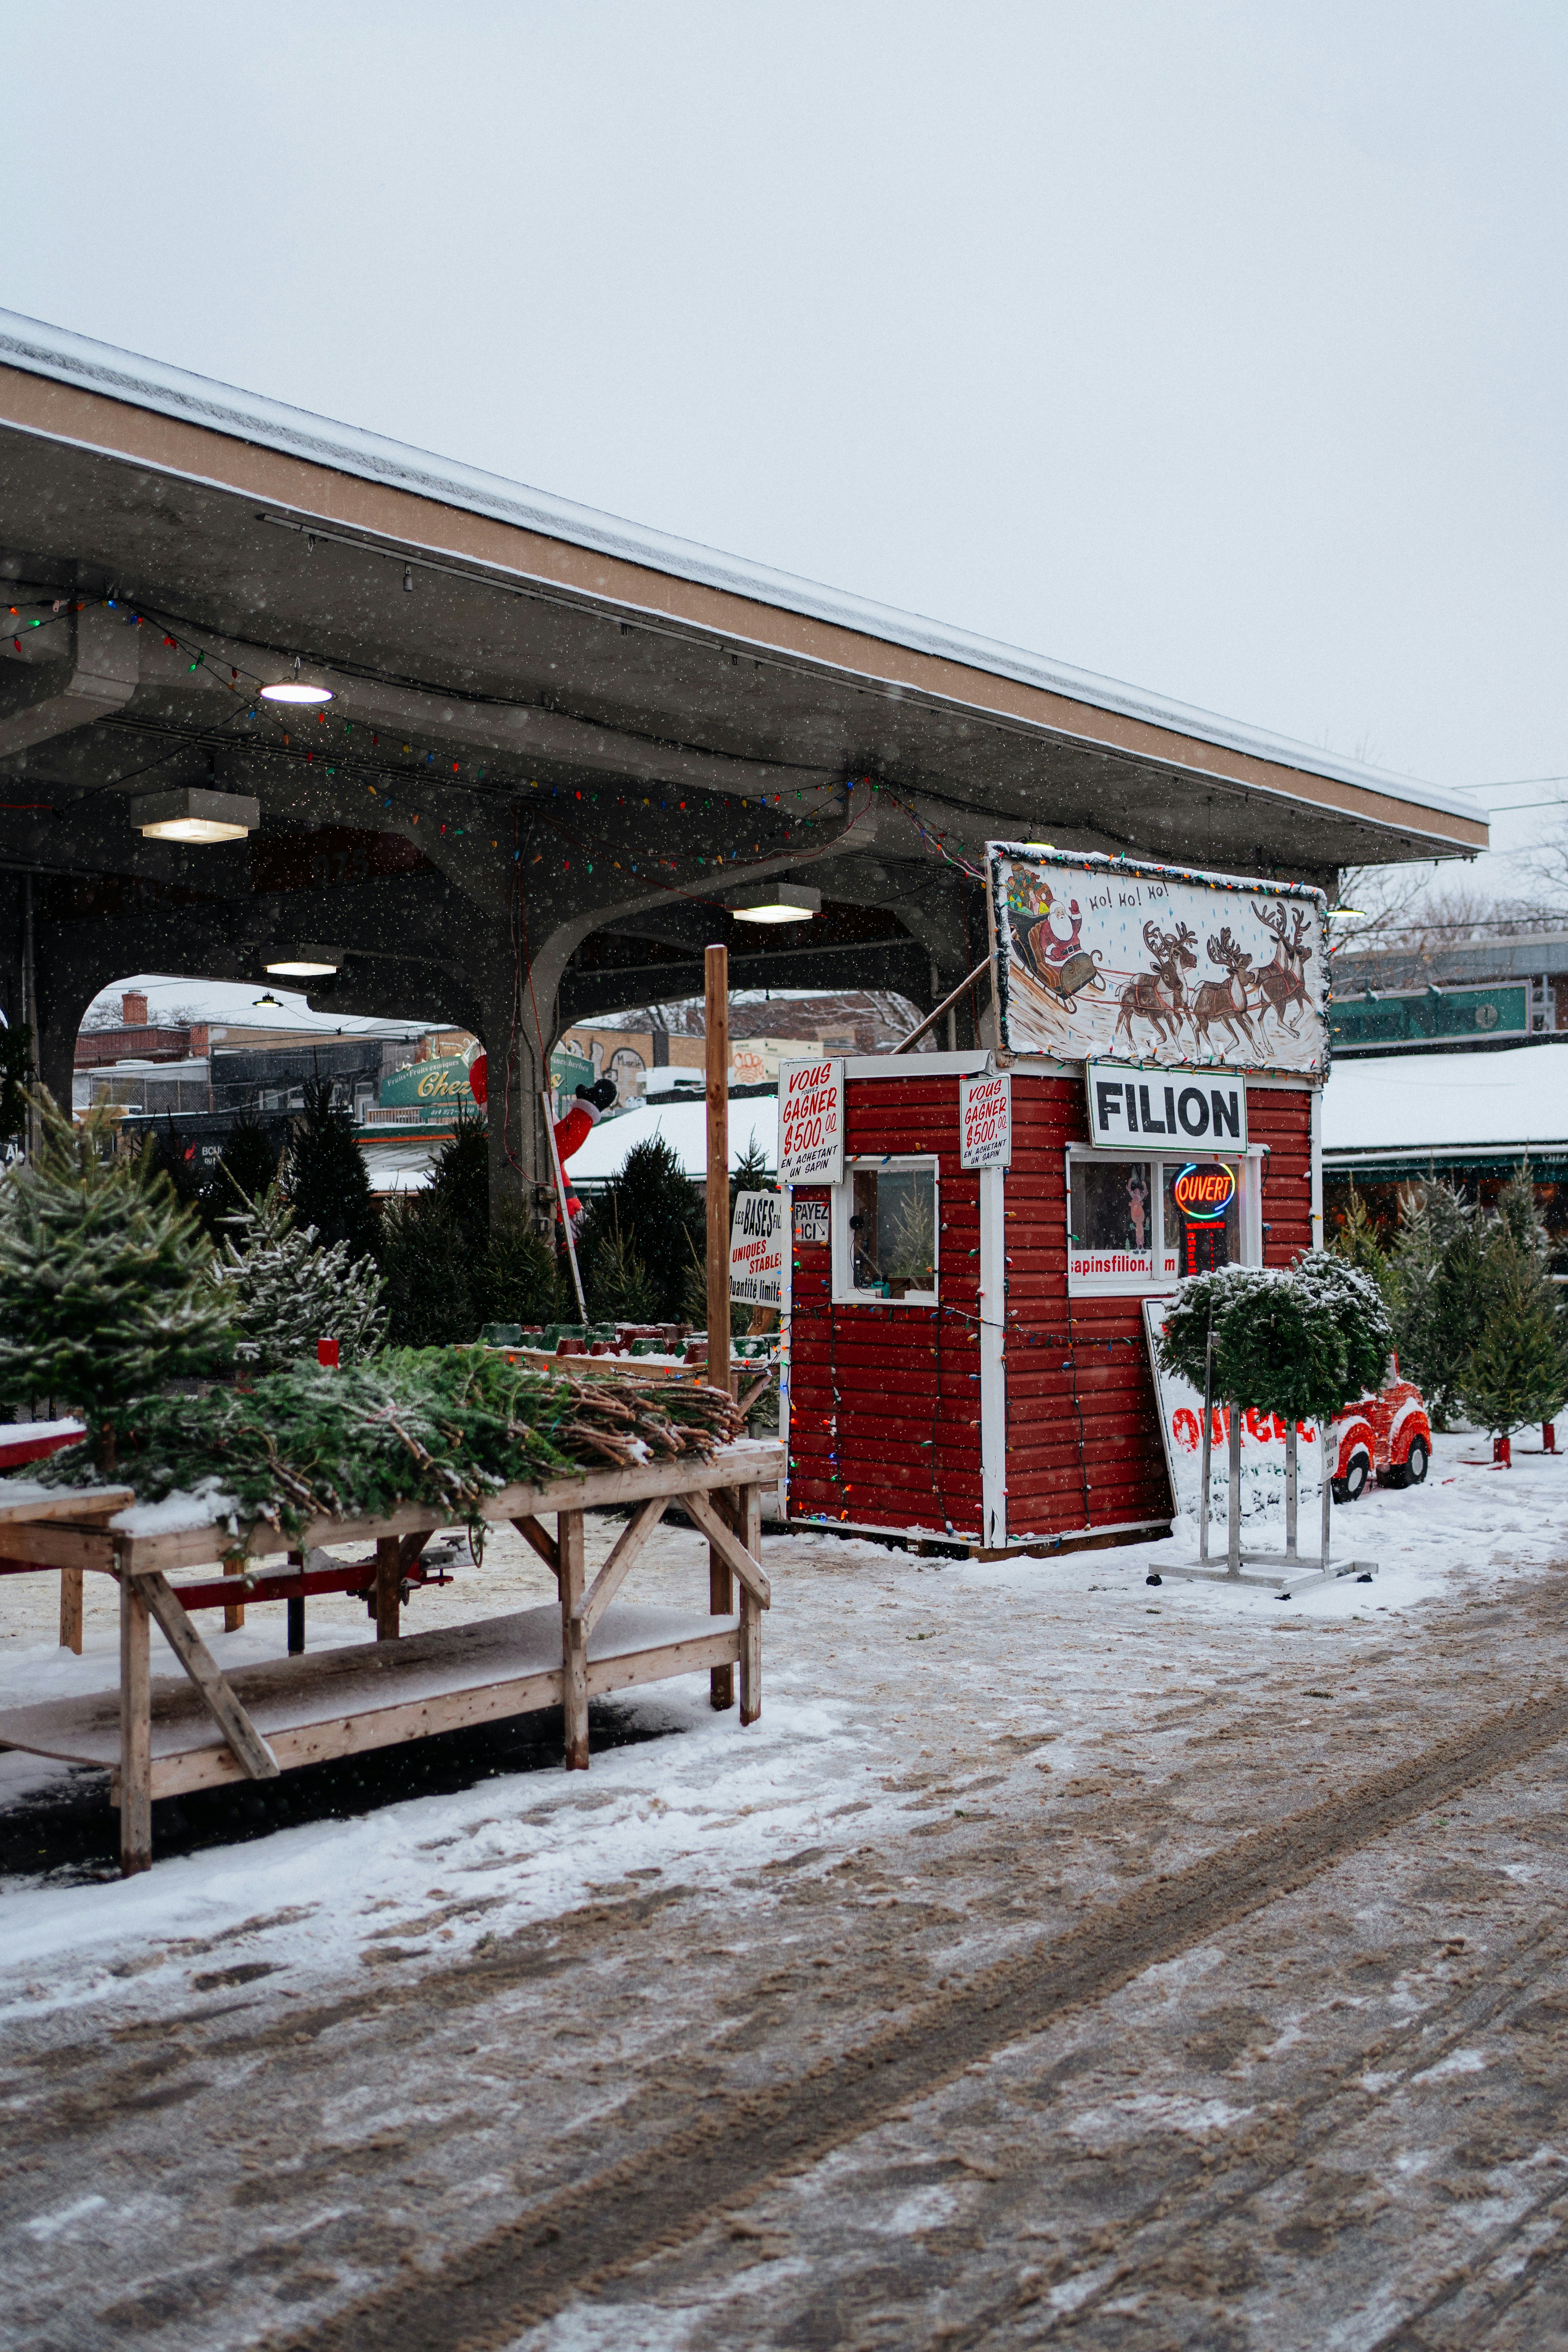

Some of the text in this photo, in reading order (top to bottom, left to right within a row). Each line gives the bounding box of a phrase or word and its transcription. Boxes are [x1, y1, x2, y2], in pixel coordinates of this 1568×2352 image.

[1089, 881, 1169, 911] HO! HO! HO!
[387, 1075, 406, 1087] Fruits
[410, 1066, 428, 1077] Fruits
[568, 1059, 589, 1072] herbes
[418, 1071, 472, 1098] Chez
[789, 1063, 831, 1093] VOUS
[801, 1086, 819, 1096] POUVEZ
[969, 1079, 1002, 1102] VOUS
[783, 1087, 837, 1123] GAGNER
[965, 1097, 1007, 1125] GAGNER
[1096, 1081, 1240, 1138] FILION
[781, 1144, 838, 1168] EN ACHETANT
[964, 1139, 1007, 1158] EN ACHETANT
[971, 1149, 1000, 1164] UN SAPIN
[790, 1158, 829, 1178] UN SAPIN
[1179, 1176, 1231, 1201] OUVERT
[735, 1198, 781, 1238] LES BASES FIL
[796, 1203, 829, 1220] PAYEZ
[801, 1223, 816, 1240] ICI
[732, 1239, 767, 1263] UNIQUES
[730, 1275, 757, 1299] Quantité
